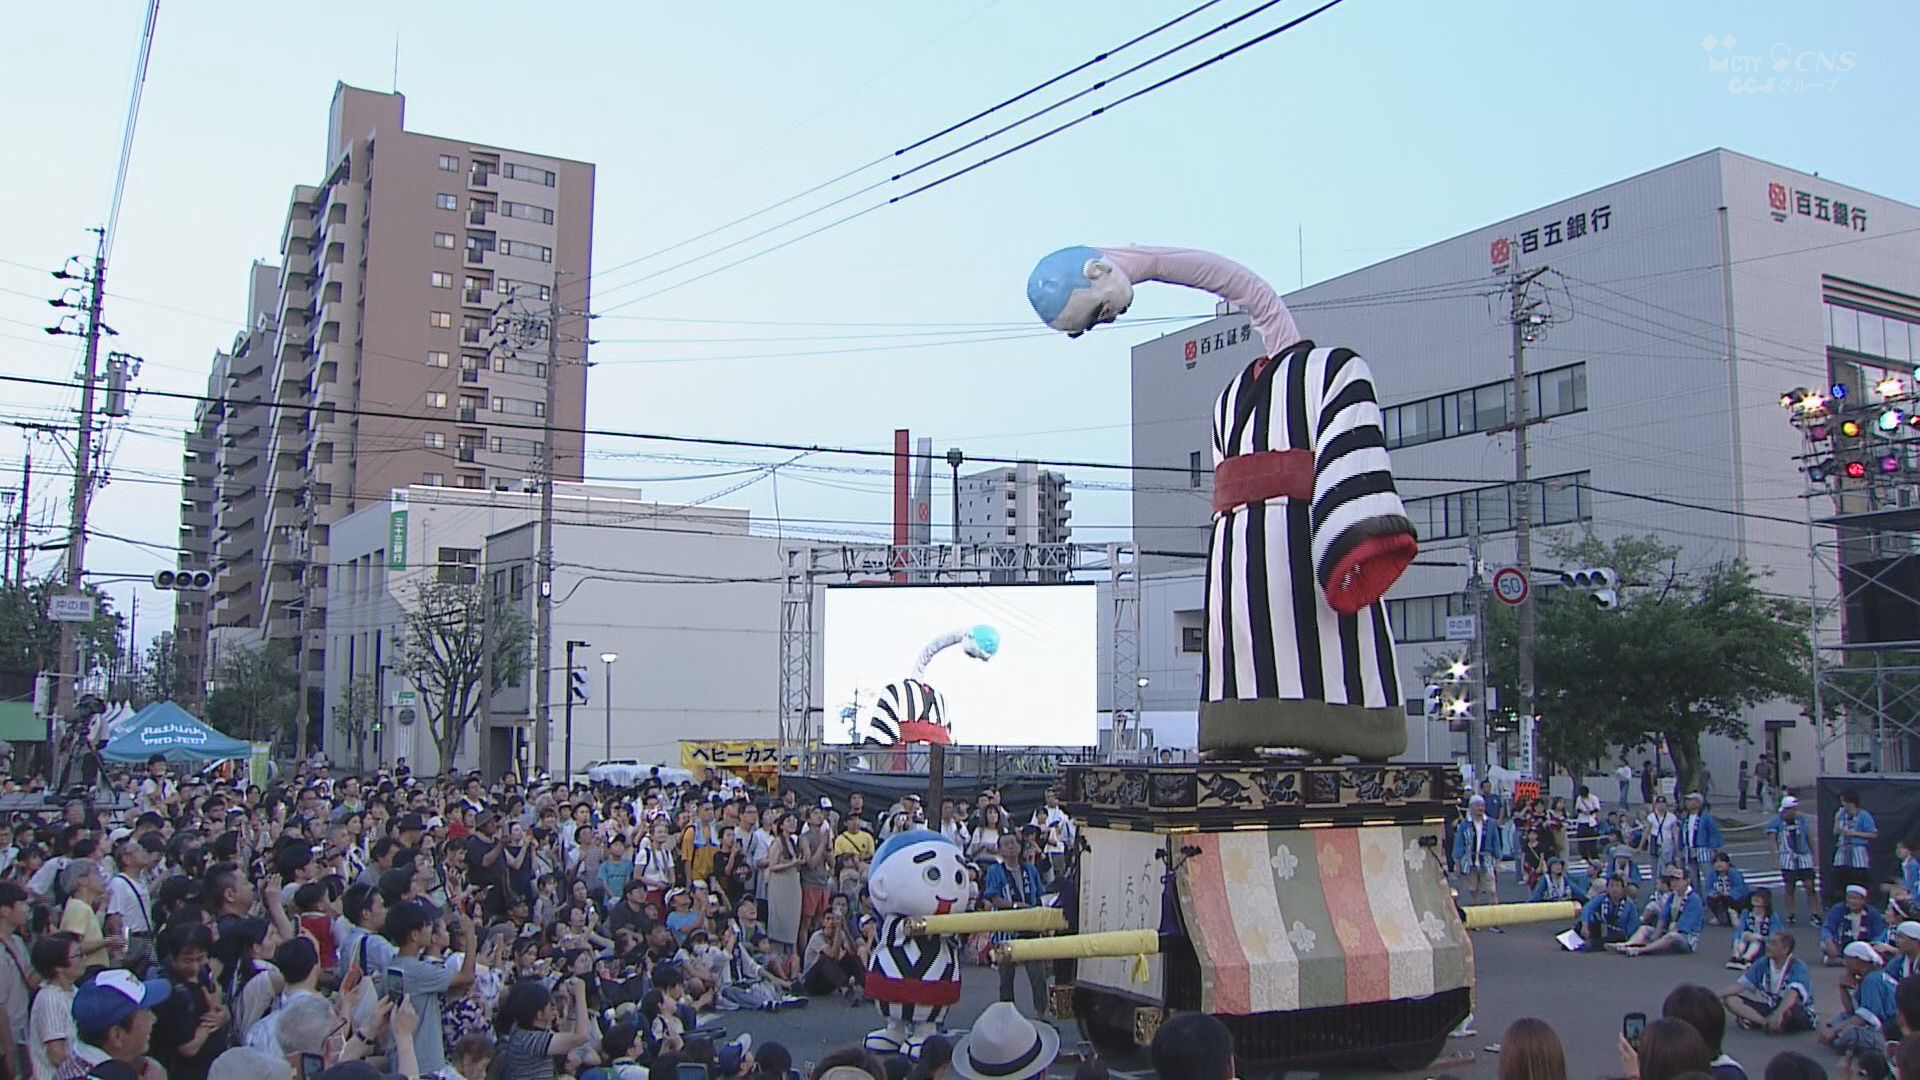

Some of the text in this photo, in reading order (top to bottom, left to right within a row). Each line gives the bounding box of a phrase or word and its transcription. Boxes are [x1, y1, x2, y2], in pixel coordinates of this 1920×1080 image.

[1520, 205, 1612, 254] 百五銀行
[1795, 190, 1867, 233] 百五銀行
[1500, 577, 1521, 596] 50
